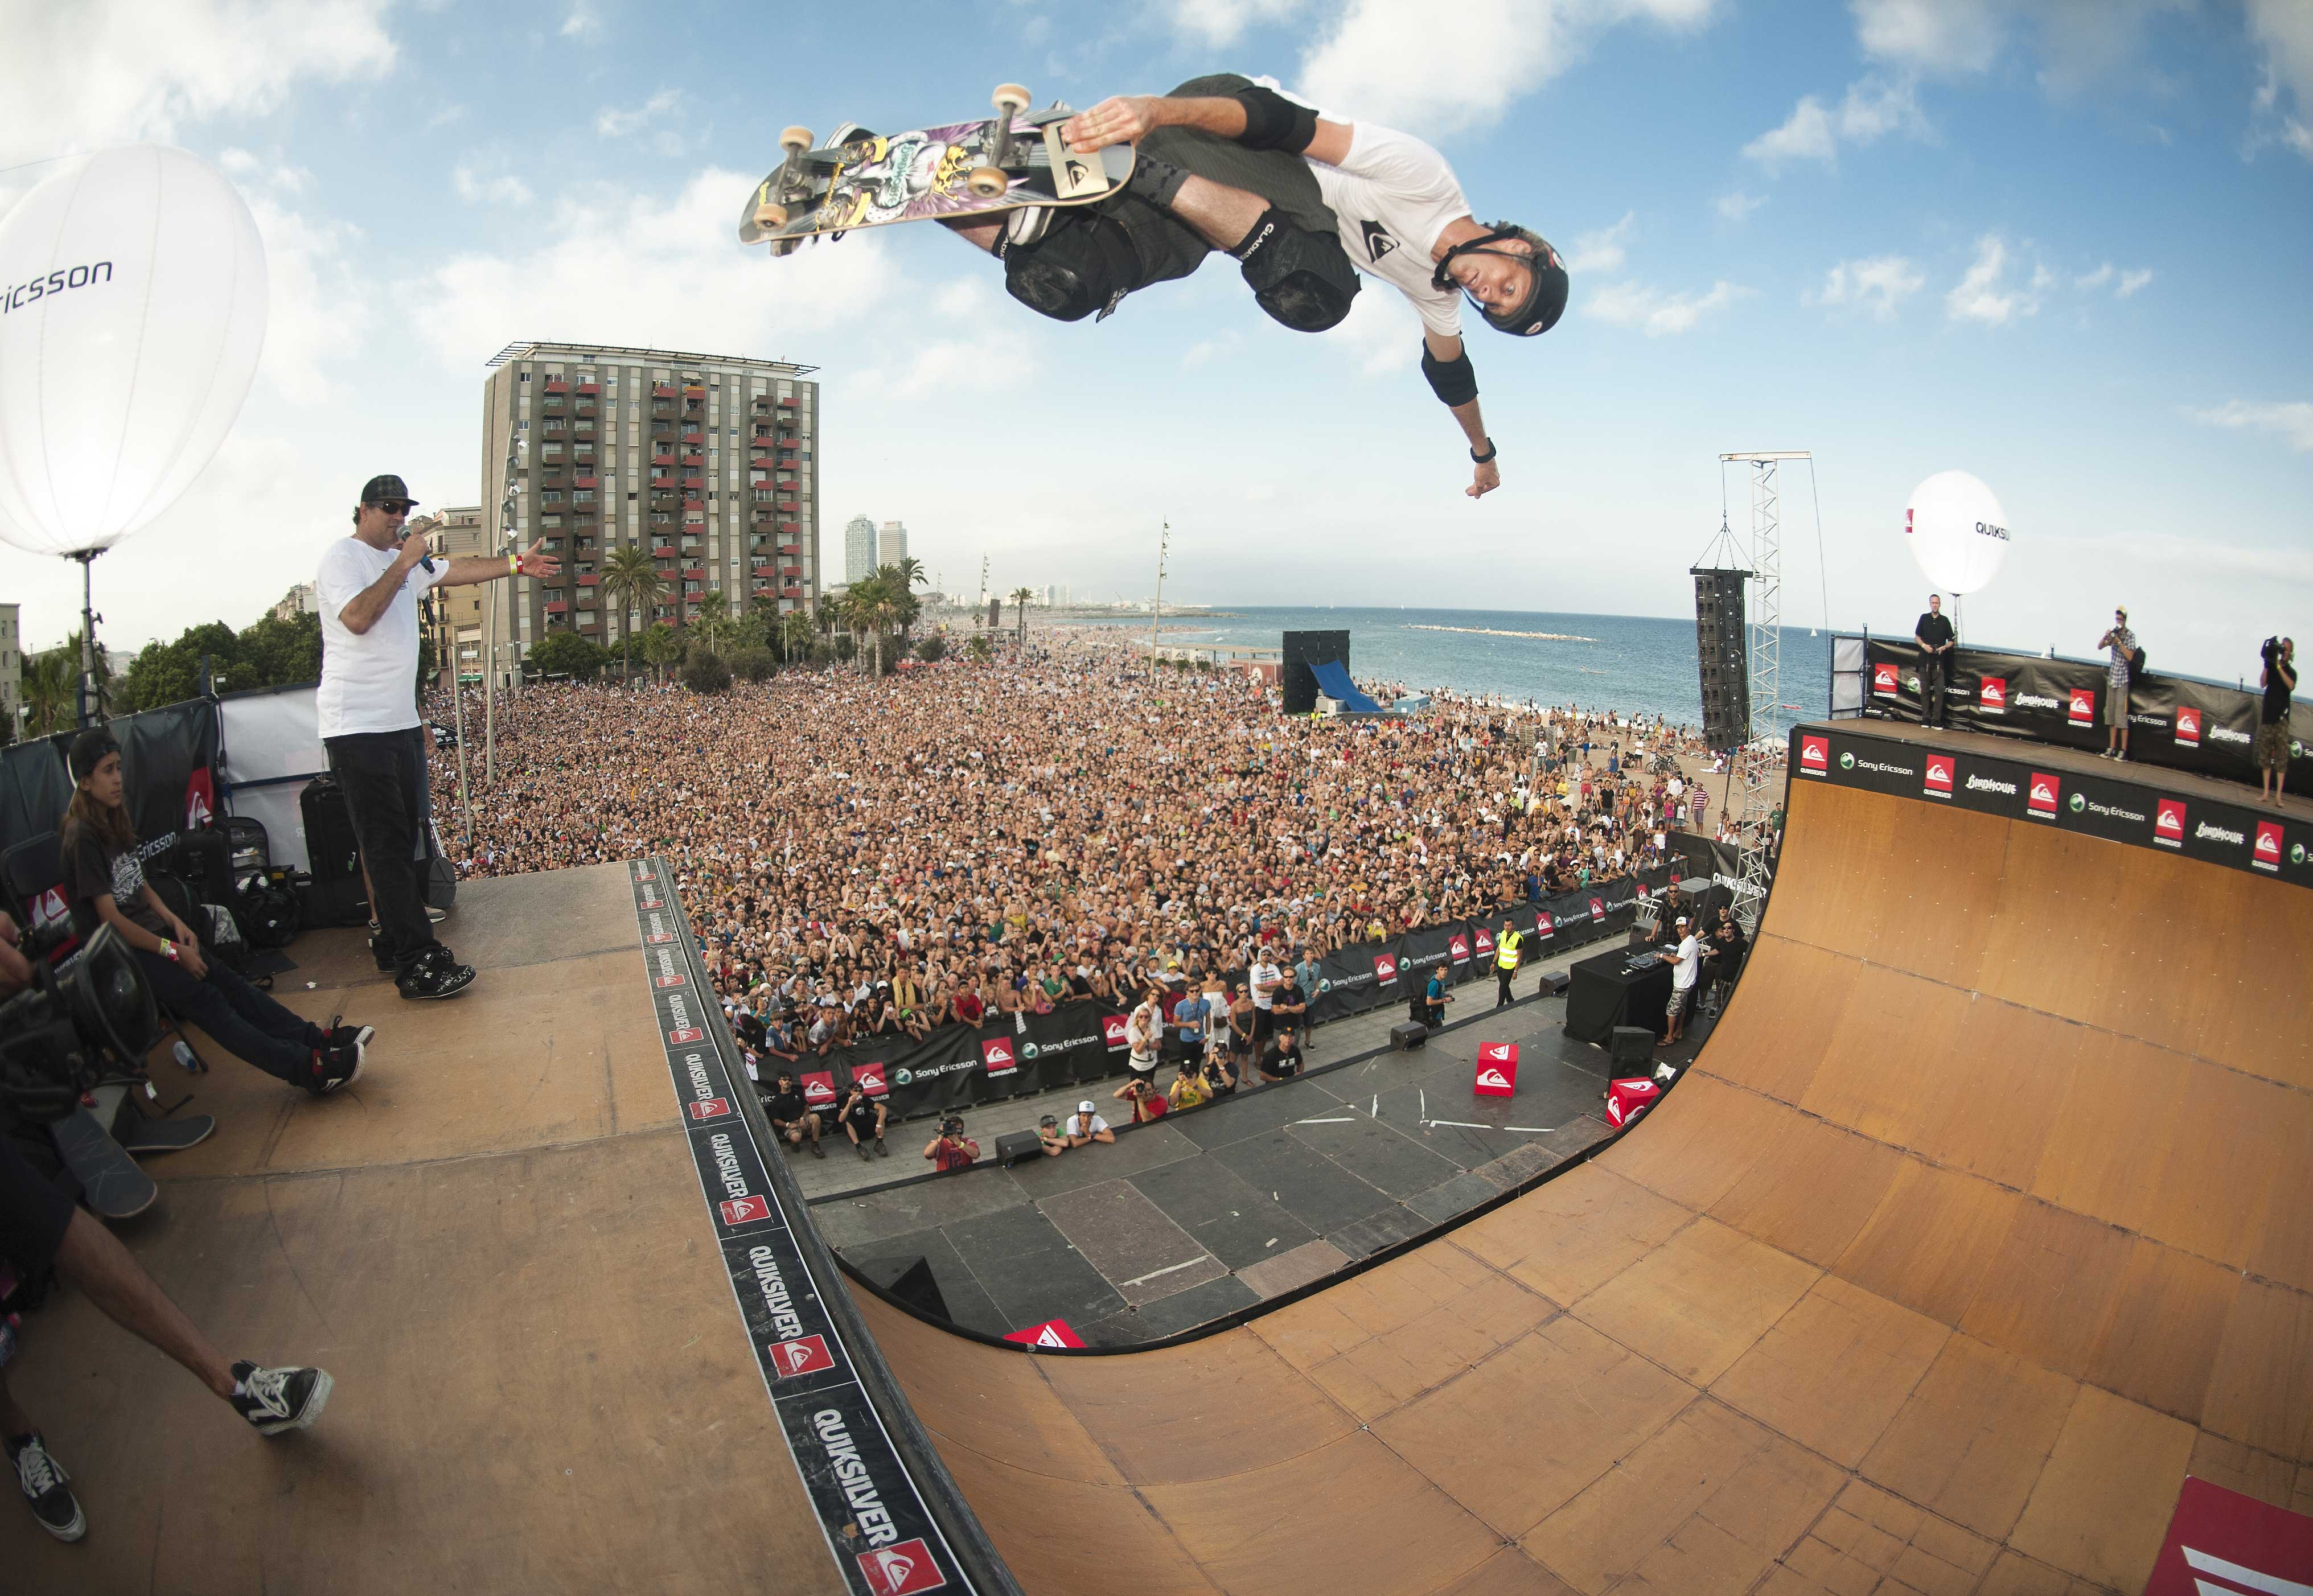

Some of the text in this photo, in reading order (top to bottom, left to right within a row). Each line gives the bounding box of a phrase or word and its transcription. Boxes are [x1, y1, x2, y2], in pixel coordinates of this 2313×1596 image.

[2138, 715, 2167, 726] Ericsson
[1858, 759, 1913, 776] Sony Ericsson
[2088, 801, 2145, 822] Sony Ericsson
[1573, 911, 1589, 920] Ericsson
[1412, 952, 1447, 965] Sony Ericsson
[1332, 972, 1373, 988] Sony Ericsson
[668, 994, 691, 1033] QUIKSILVER
[1041, 1034, 1098, 1052] Sony Ericsson
[685, 1053, 714, 1102] QUIKSILVER
[915, 1059, 977, 1079] Sony Ericsson
[809, 1103, 837, 1111] UIKSILVER
[710, 1132, 749, 1199] QUIKSILVER
[749, 1245, 803, 1341] QUIKSILVER
[814, 1408, 898, 1549] QUIKSILVER
